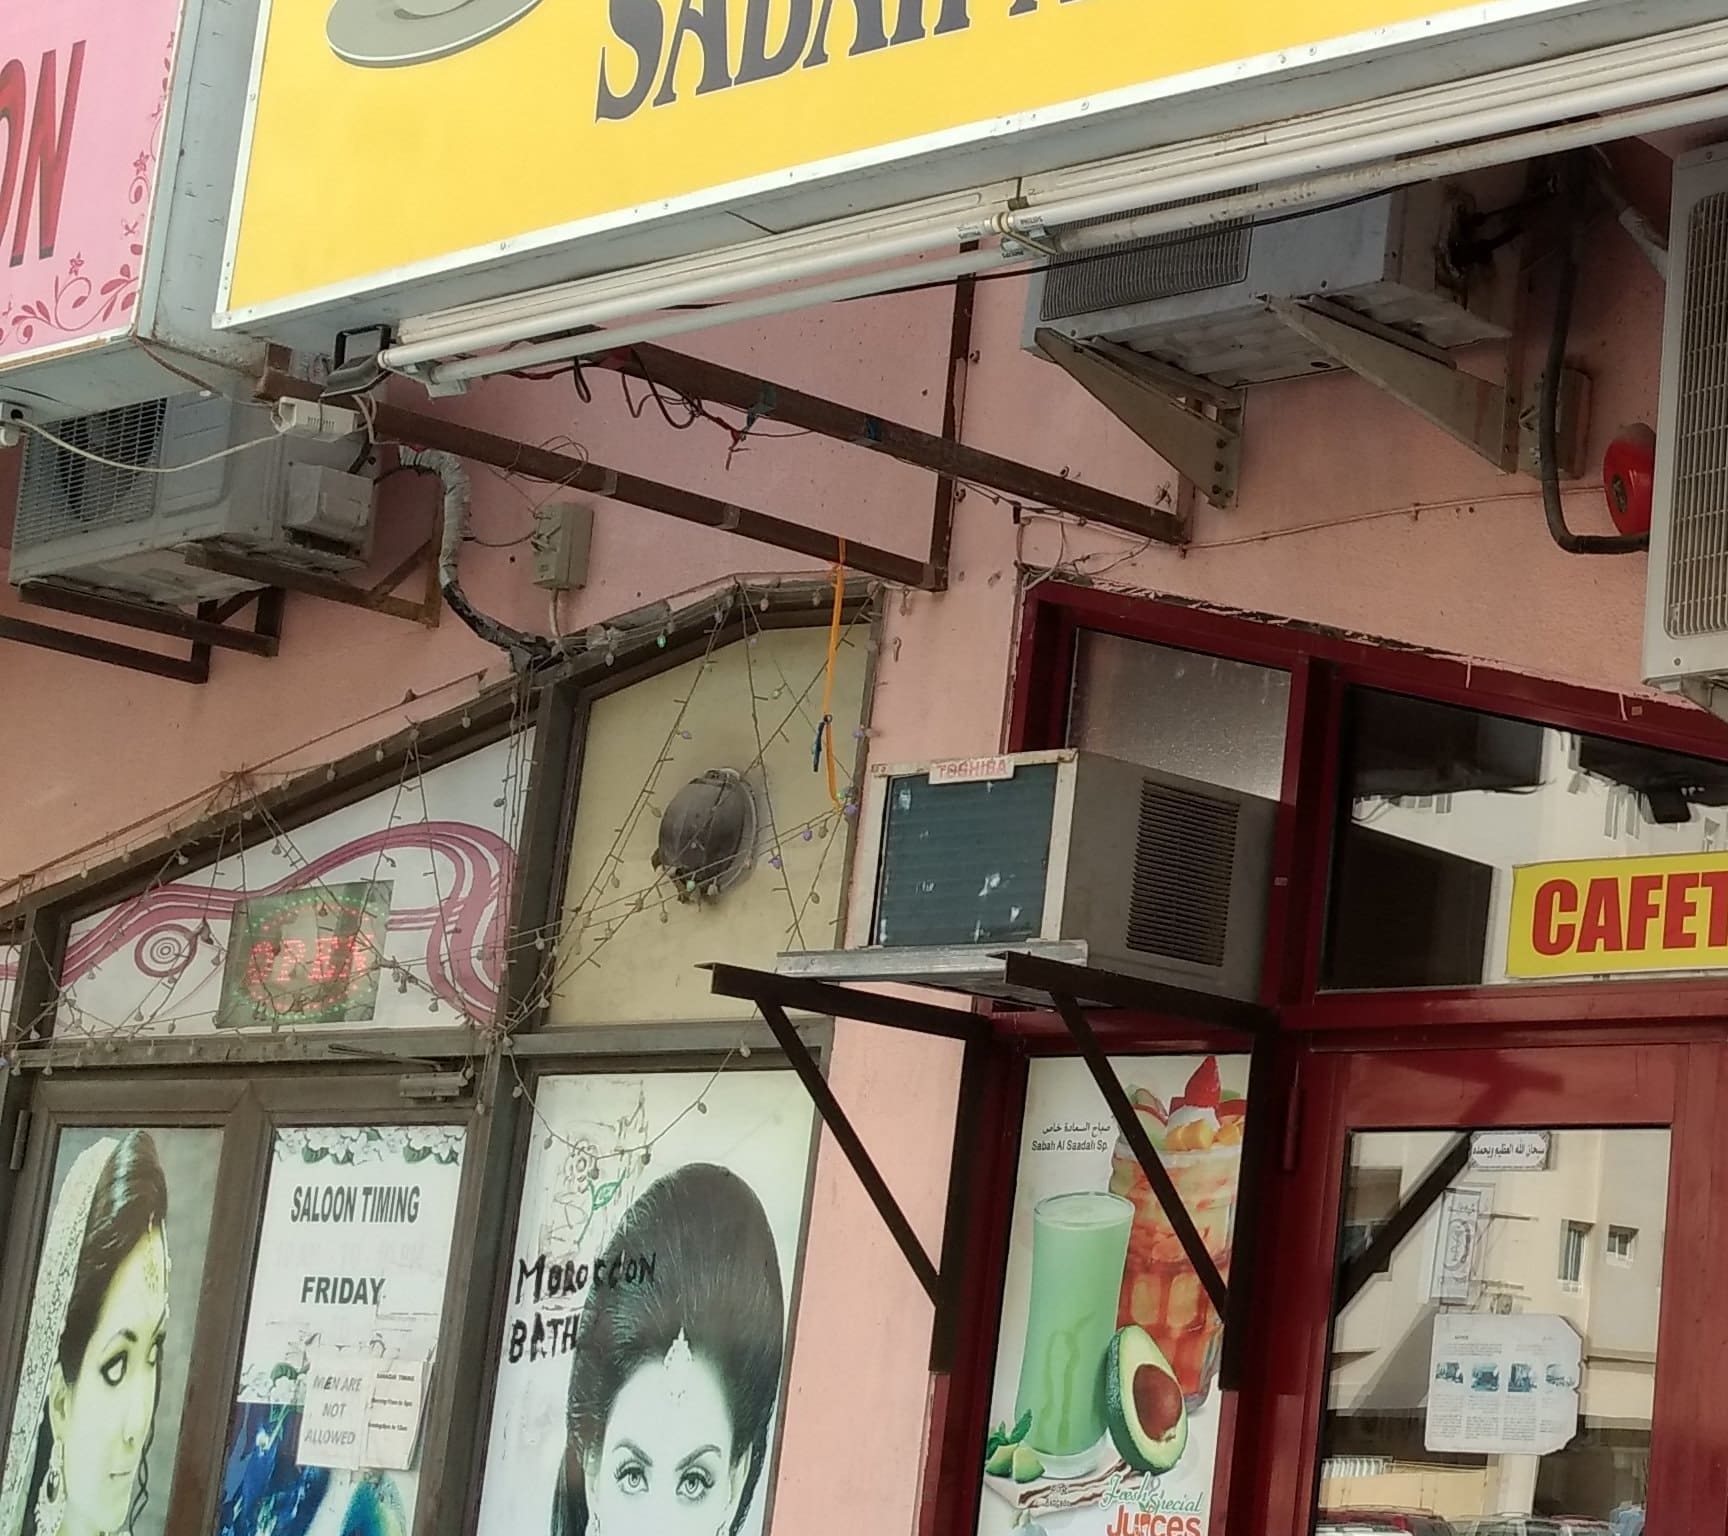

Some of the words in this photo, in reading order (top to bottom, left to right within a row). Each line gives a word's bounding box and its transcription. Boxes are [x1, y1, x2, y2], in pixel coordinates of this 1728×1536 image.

[1032, 1139, 1055, 1152] Sabah
[1067, 1139, 1095, 1151] Saadah
[290, 1185, 358, 1223] SALOON
[361, 1185, 420, 1223] TIMING
[301, 1275, 385, 1305] FRIDAY
[509, 1312, 580, 1363] BATH
[313, 1375, 341, 1392] MEN
[341, 1376, 363, 1392] ARE
[322, 1402, 347, 1418] NOT
[303, 1428, 356, 1446] ALLOWED
[1100, 1471, 1150, 1510] Fresh
[1149, 1491, 1203, 1515] Special
